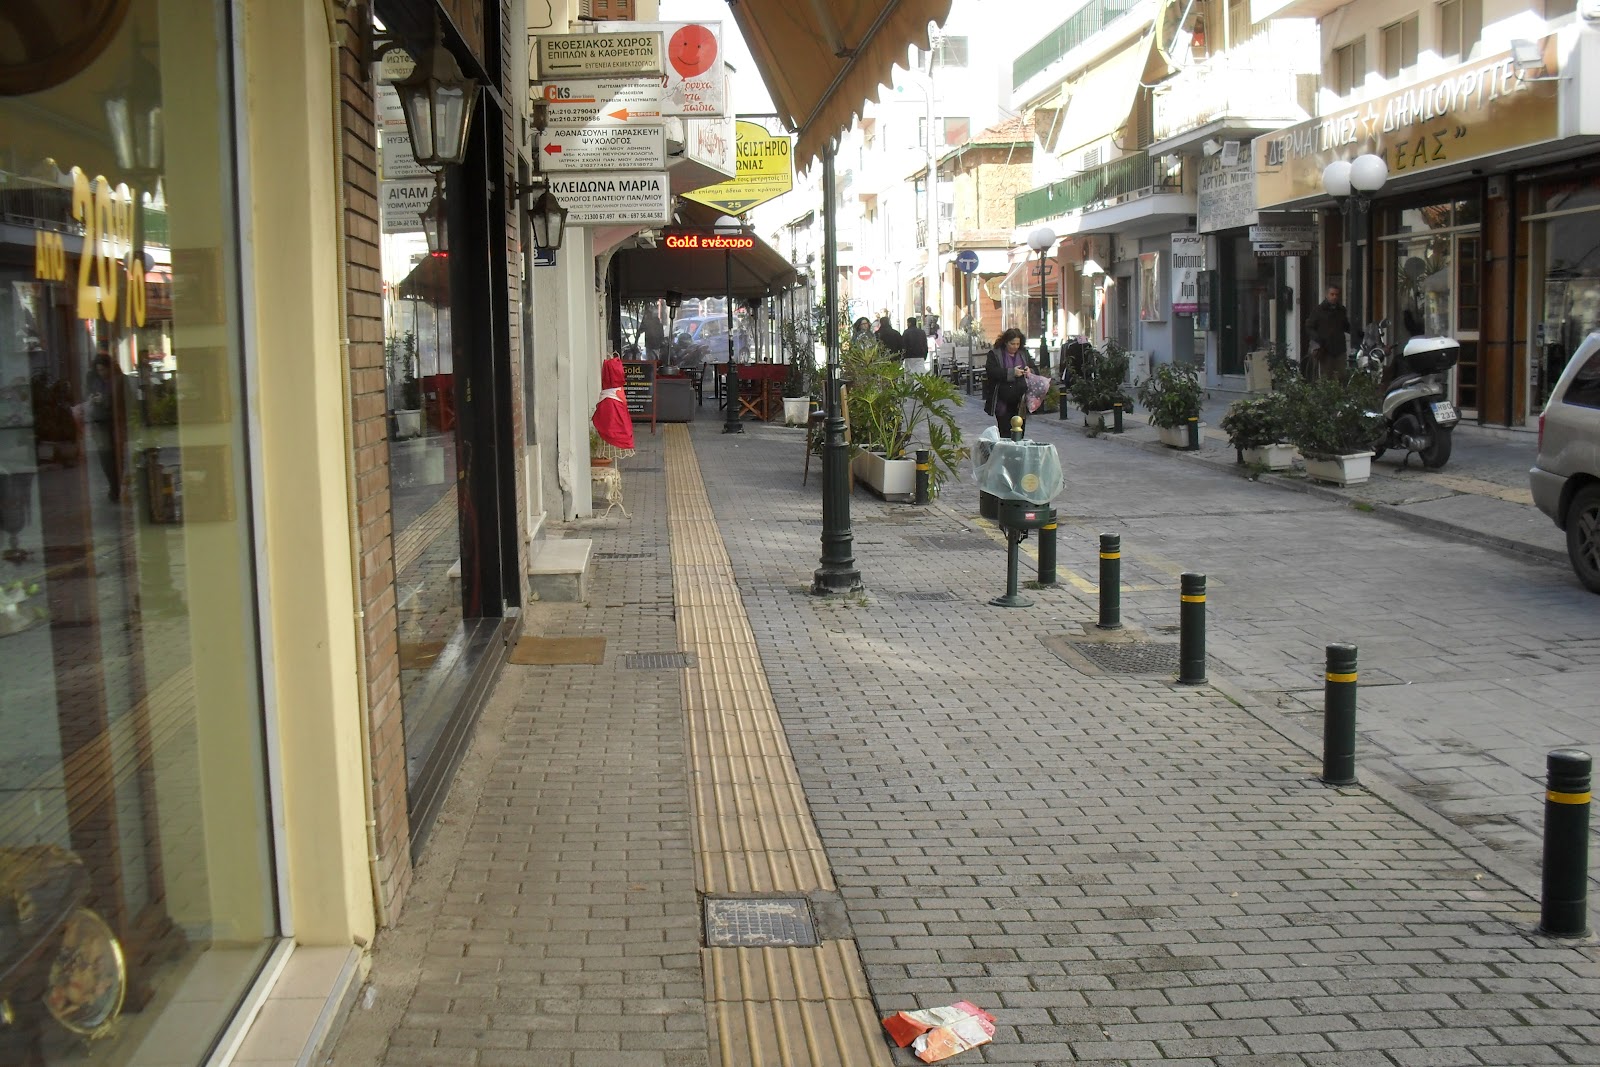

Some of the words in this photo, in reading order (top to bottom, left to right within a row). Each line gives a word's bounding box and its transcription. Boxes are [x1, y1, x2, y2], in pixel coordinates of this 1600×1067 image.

[548, 39, 614, 50] ΕΚΘΕΣΙΑΚΟΣ
[616, 38, 652, 48] ΧΩΡΟΣ
[548, 50, 587, 60] ΕΠΙΠΛΩΝ
[598, 48, 653, 57] ΚΑΘΡΕΦΤΩΝ
[549, 87, 570, 100] CKS
[1268, 110, 1360, 166] ΔΕΡΜΑΤΙΝΕΣ
[736, 140, 788, 157] ΝΕΙΣΤΗΡΙΟ
[552, 181, 615, 193] ΚΛΕΙΔΩΝΑ
[619, 180, 660, 192] ΜΑΡΙΑ
[666, 235, 698, 249] Gold
[701, 234, 753, 249] ενέχυρο
[1173, 236, 1200, 244] enjoy
[1173, 253, 1201, 268] Ποιότητα
